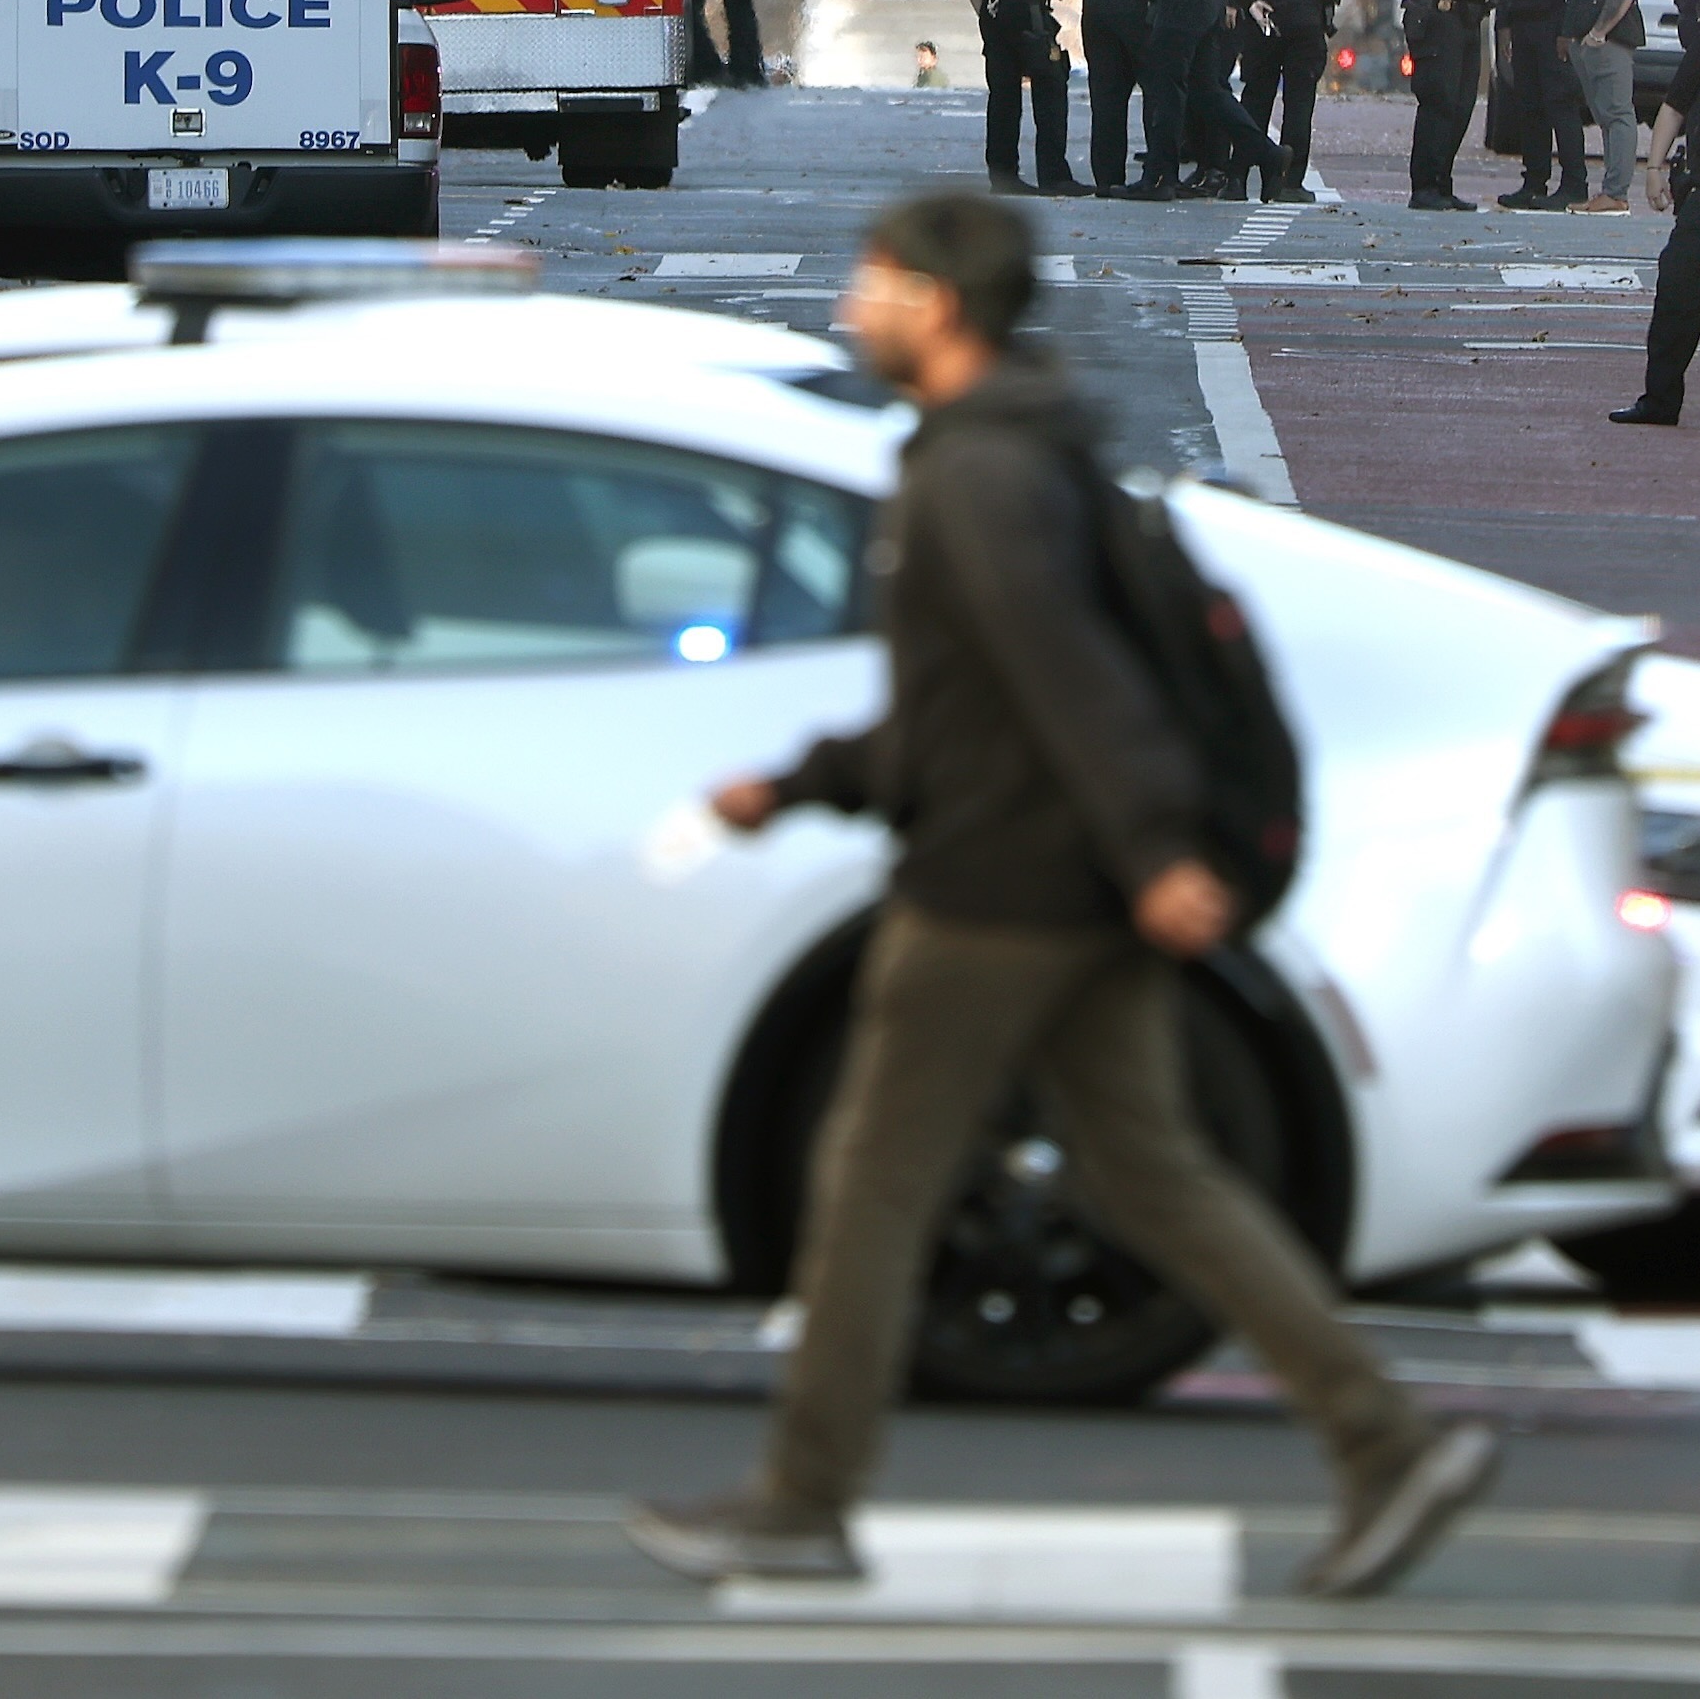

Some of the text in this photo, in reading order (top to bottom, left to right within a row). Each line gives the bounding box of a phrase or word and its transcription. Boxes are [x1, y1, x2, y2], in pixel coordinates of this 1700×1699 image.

[123, 50, 253, 106] K-9
[20, 130, 360, 151] SOD 8967
[179, 180, 219, 199] 10466
